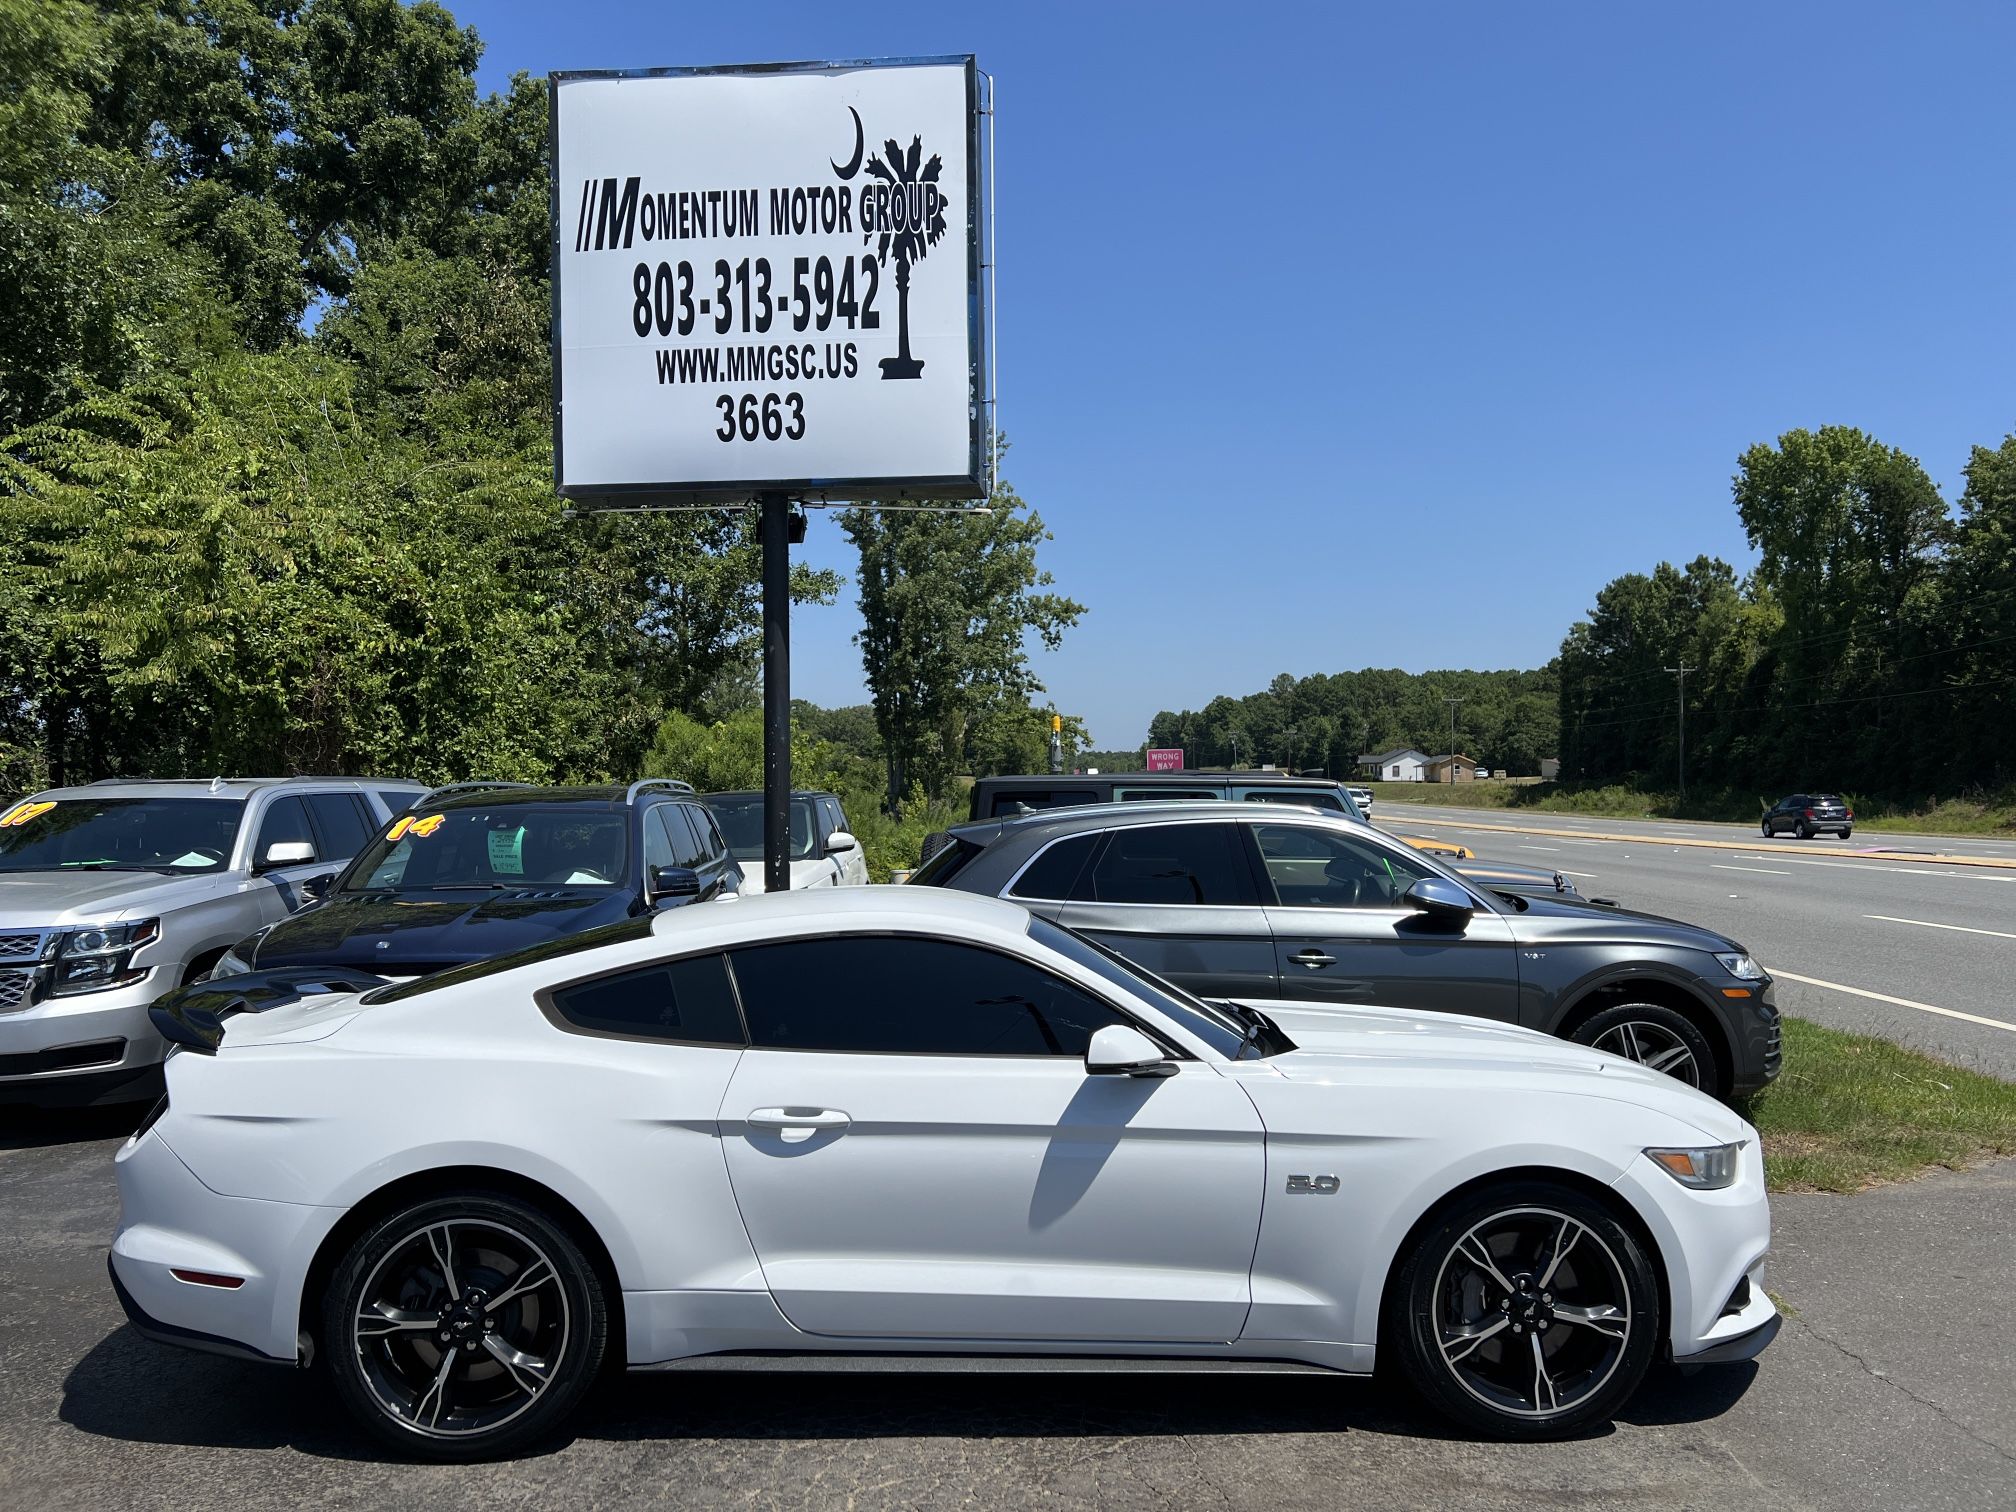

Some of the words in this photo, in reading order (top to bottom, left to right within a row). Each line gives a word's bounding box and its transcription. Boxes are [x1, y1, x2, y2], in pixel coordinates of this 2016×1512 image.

[769, 185, 853, 236] MOTOR
[859, 181, 940, 234] GROUP
[632, 254, 880, 338] 803-313-5942
[656, 342, 858, 385] WWW.MMGSC.US
[715, 391, 806, 443] 3663
[1151, 753, 1179, 761] WRONG
[1156, 762, 1174, 770] WAY
[0, 801, 58, 828] 17
[385, 814, 446, 841] 14
[1286, 1174, 1341, 1195] 5.0
